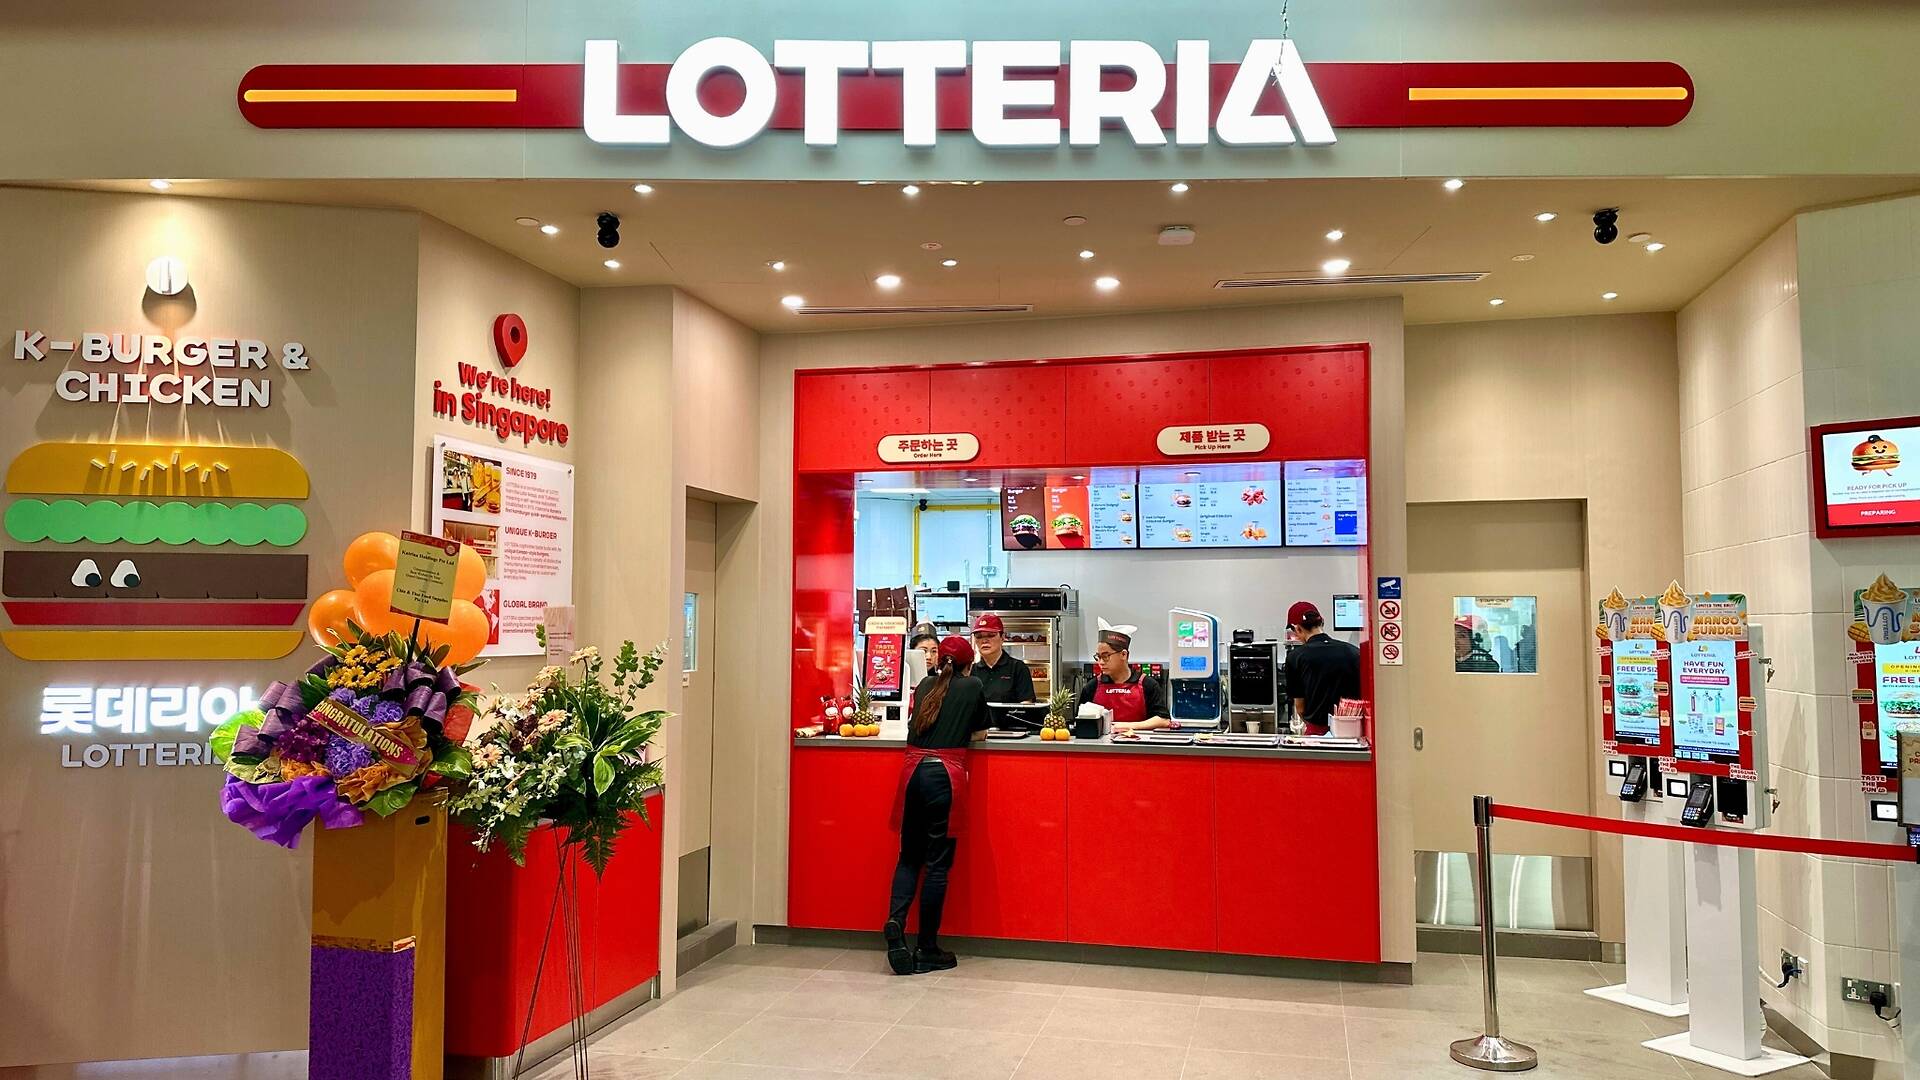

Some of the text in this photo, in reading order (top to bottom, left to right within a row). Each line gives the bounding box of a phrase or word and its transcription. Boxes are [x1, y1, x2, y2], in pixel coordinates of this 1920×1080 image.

[583, 36, 1336, 148] LOTTERIA
[14, 330, 310, 371] K-BURGER &
[55, 370, 271, 409] CHICKEN
[458, 361, 552, 412] We're here!
[433, 380, 569, 445] in Singapore
[1180, 428, 1246, 443] 제품 받는 곳
[897, 438, 958, 452] 주문하는 곳
[506, 467, 524, 478] SINCE
[505, 526, 557, 540] UNIQUE K-BURGER
[503, 600, 527, 608] GLOBAL
[1631, 617, 1654, 625] MAN
[1694, 616, 1740, 625] MANGO
[1630, 626, 1650, 634] SUN
[1692, 626, 1742, 635] SUNDAE
[1683, 667, 1727, 675] EVERYDAY
[1882, 676, 1915, 684] FREE
[62, 742, 224, 768] LOTTERI
